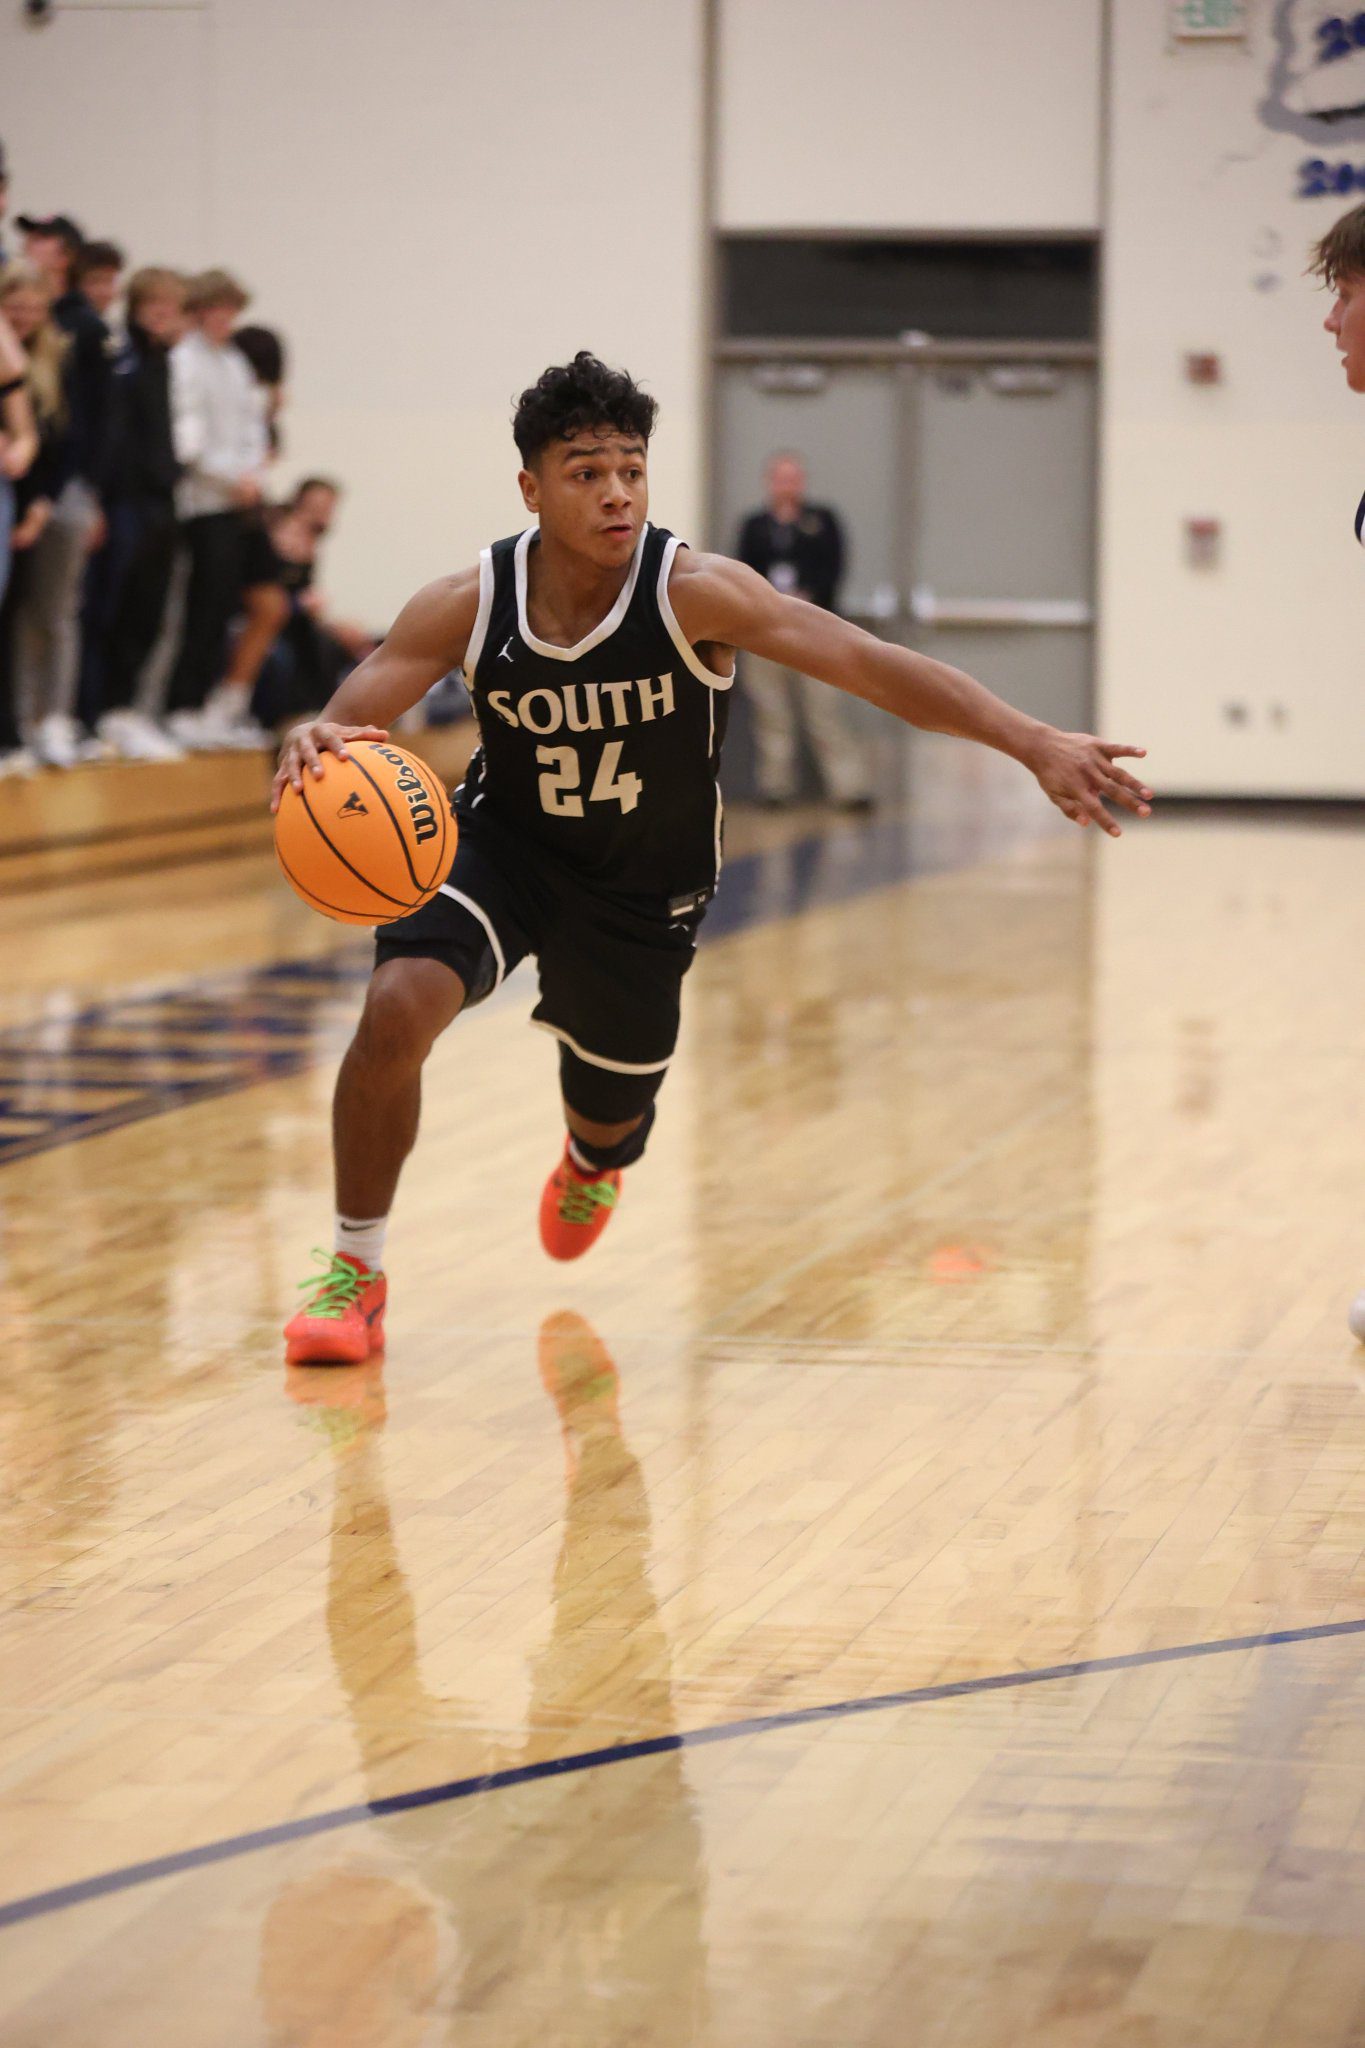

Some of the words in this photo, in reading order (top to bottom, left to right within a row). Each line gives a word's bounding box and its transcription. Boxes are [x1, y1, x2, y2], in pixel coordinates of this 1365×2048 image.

[487, 672, 675, 735] SOUTH
[368, 743, 438, 846] Wilson
[535, 740, 643, 818] 24
